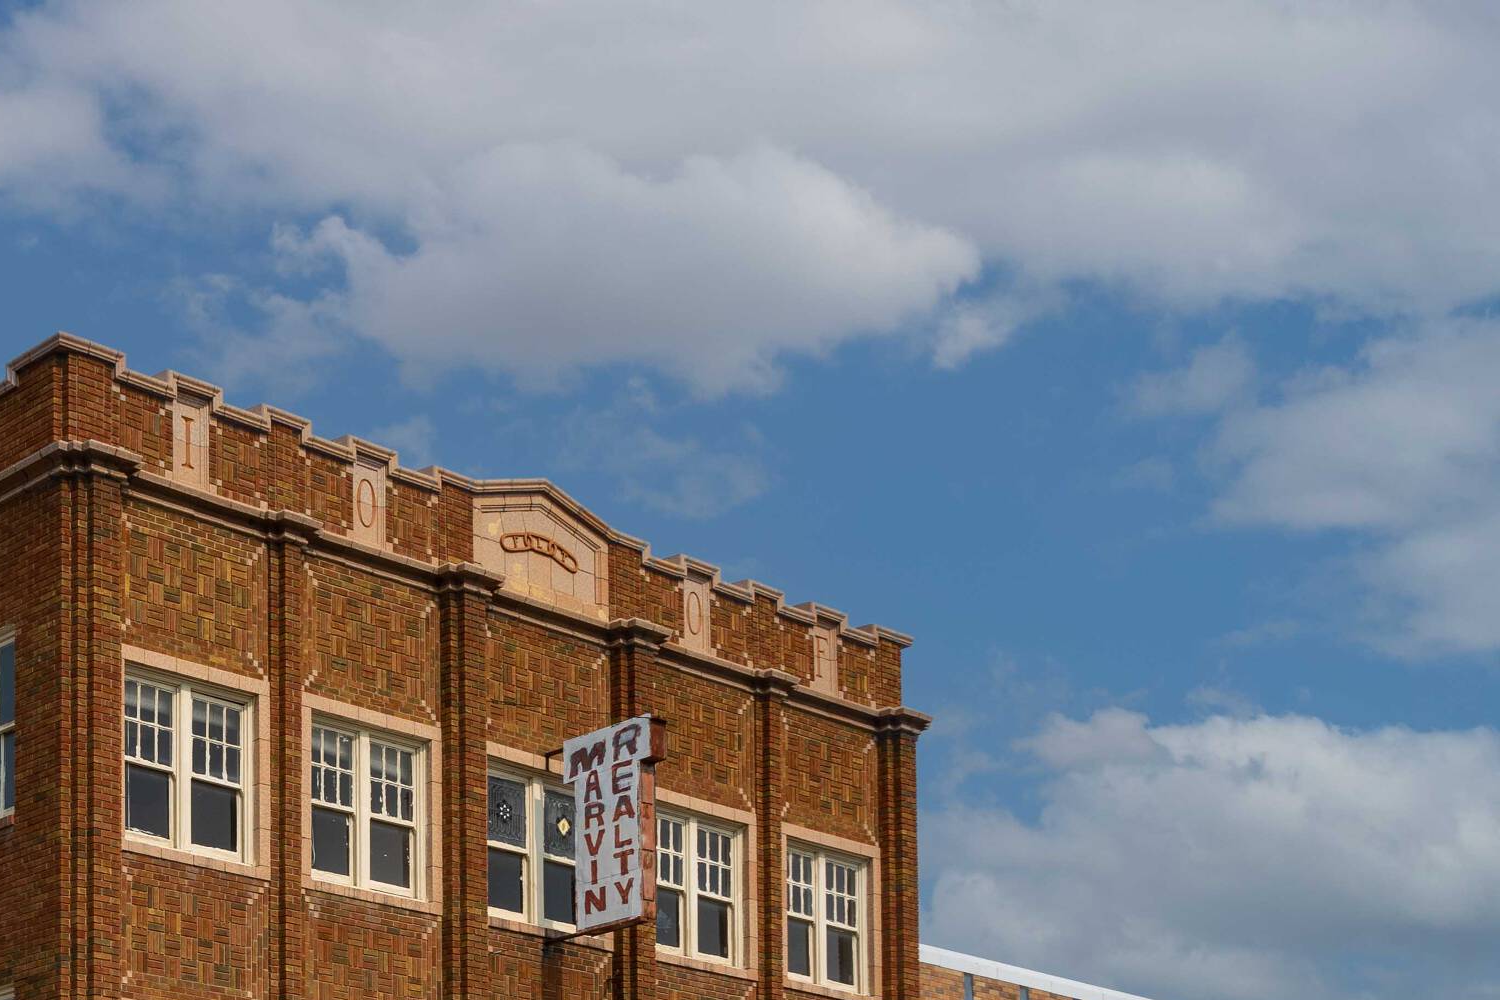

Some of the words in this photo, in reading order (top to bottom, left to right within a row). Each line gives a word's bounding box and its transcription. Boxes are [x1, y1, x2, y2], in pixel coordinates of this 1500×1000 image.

[816, 635, 828, 678] F
[569, 739, 606, 915] MARVIN
[611, 723, 642, 905] REALTY
